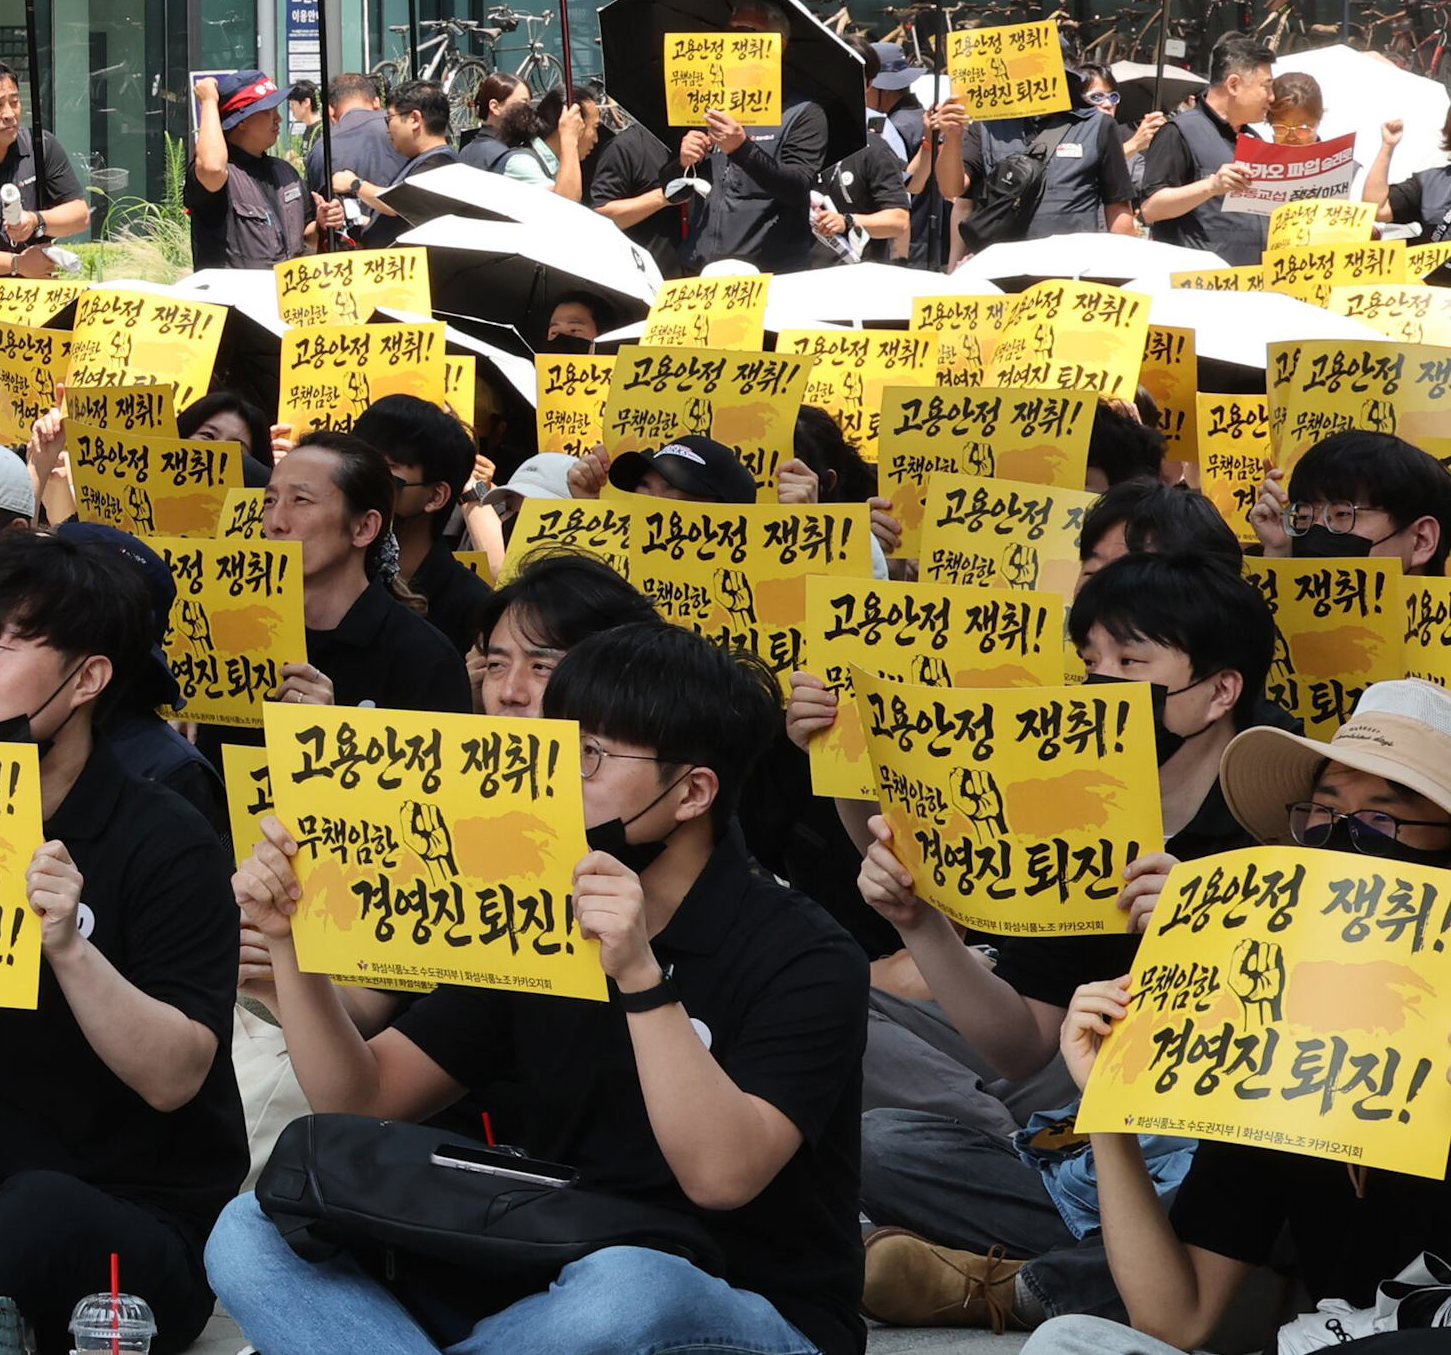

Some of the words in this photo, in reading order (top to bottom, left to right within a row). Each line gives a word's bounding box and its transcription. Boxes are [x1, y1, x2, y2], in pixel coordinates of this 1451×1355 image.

[673, 39, 723, 60] 고용안정
[733, 39, 771, 60] 쟁취!
[953, 33, 1001, 57] 고용안정
[1009, 28, 1048, 51] 쟁취!
[670, 70, 705, 87] 무책임한
[952, 66, 988, 84] 무책임한
[967, 83, 1013, 108] 경영진
[1017, 78, 1056, 102] 퇴진!
[687, 90, 724, 113] 경영진
[730, 90, 771, 112] 퇴진!
[1272, 251, 1334, 285] 고용안정
[1345, 248, 1394, 277] 쟁취!
[292, 333, 370, 369] 고용안정
[380, 331, 434, 365] 쟁취!
[624, 355, 726, 394] 고용안정
[732, 360, 800, 395] 쟁취!
[642, 511, 747, 563] 고용안정
[763, 515, 852, 564] 쟁취!
[867, 693, 994, 761] 고용안정
[1015, 699, 1129, 761] 쟁취!
[292, 722, 441, 794] 고용안정
[460, 732, 559, 801] 쟁취!
[879, 764, 948, 825] 무책임한
[296, 815, 399, 868] 무책임한
[916, 832, 1018, 899] 경영진
[1022, 839, 1141, 906] 퇴진!
[351, 873, 472, 947] 경영진
[475, 884, 578, 955] 퇴진!
